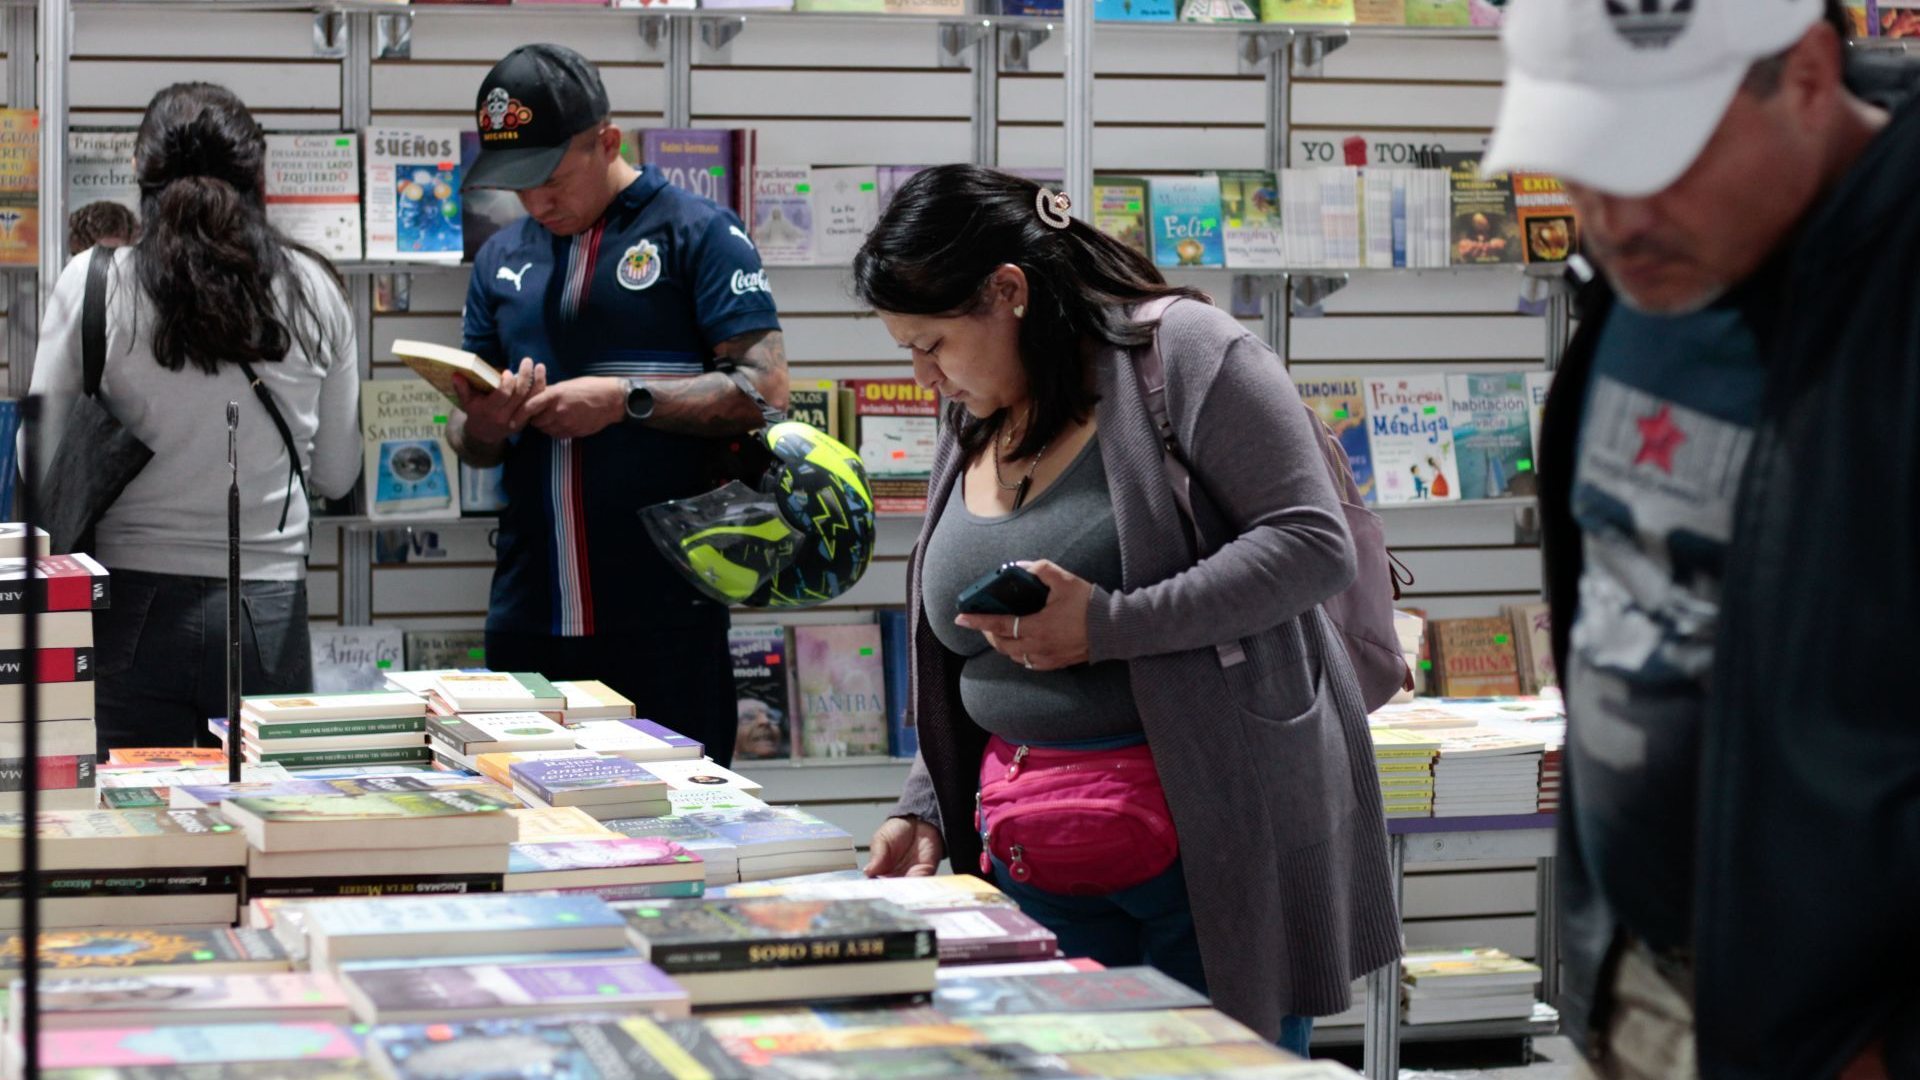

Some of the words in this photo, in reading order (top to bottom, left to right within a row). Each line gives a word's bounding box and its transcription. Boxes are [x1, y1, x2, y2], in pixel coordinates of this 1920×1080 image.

[75, 137, 138, 154] Principio
[375, 136, 452, 157] SUEÑOS
[1301, 142, 1335, 161] YO
[327, 160, 353, 168] LADO
[73, 169, 138, 185] cerebra
[276, 171, 348, 184] IZQUIERDO
[755, 168, 807, 178] raciones
[1164, 215, 1213, 239] Feliz
[1297, 382, 1358, 397] REMONIAS
[1370, 382, 1443, 409] Princesa
[377, 390, 441, 405] GRANDES
[1452, 397, 1524, 411] habitación
[1373, 412, 1449, 444] Méndiga
[733, 666, 771, 677] moria
[387, 884, 399, 893] LA
[400, 883, 414, 892] DE
[416, 882, 467, 894] ENIGMAS
[749, 946, 809, 962] OROS
[813, 944, 840, 958] DE
[844, 942, 885, 957] REY
